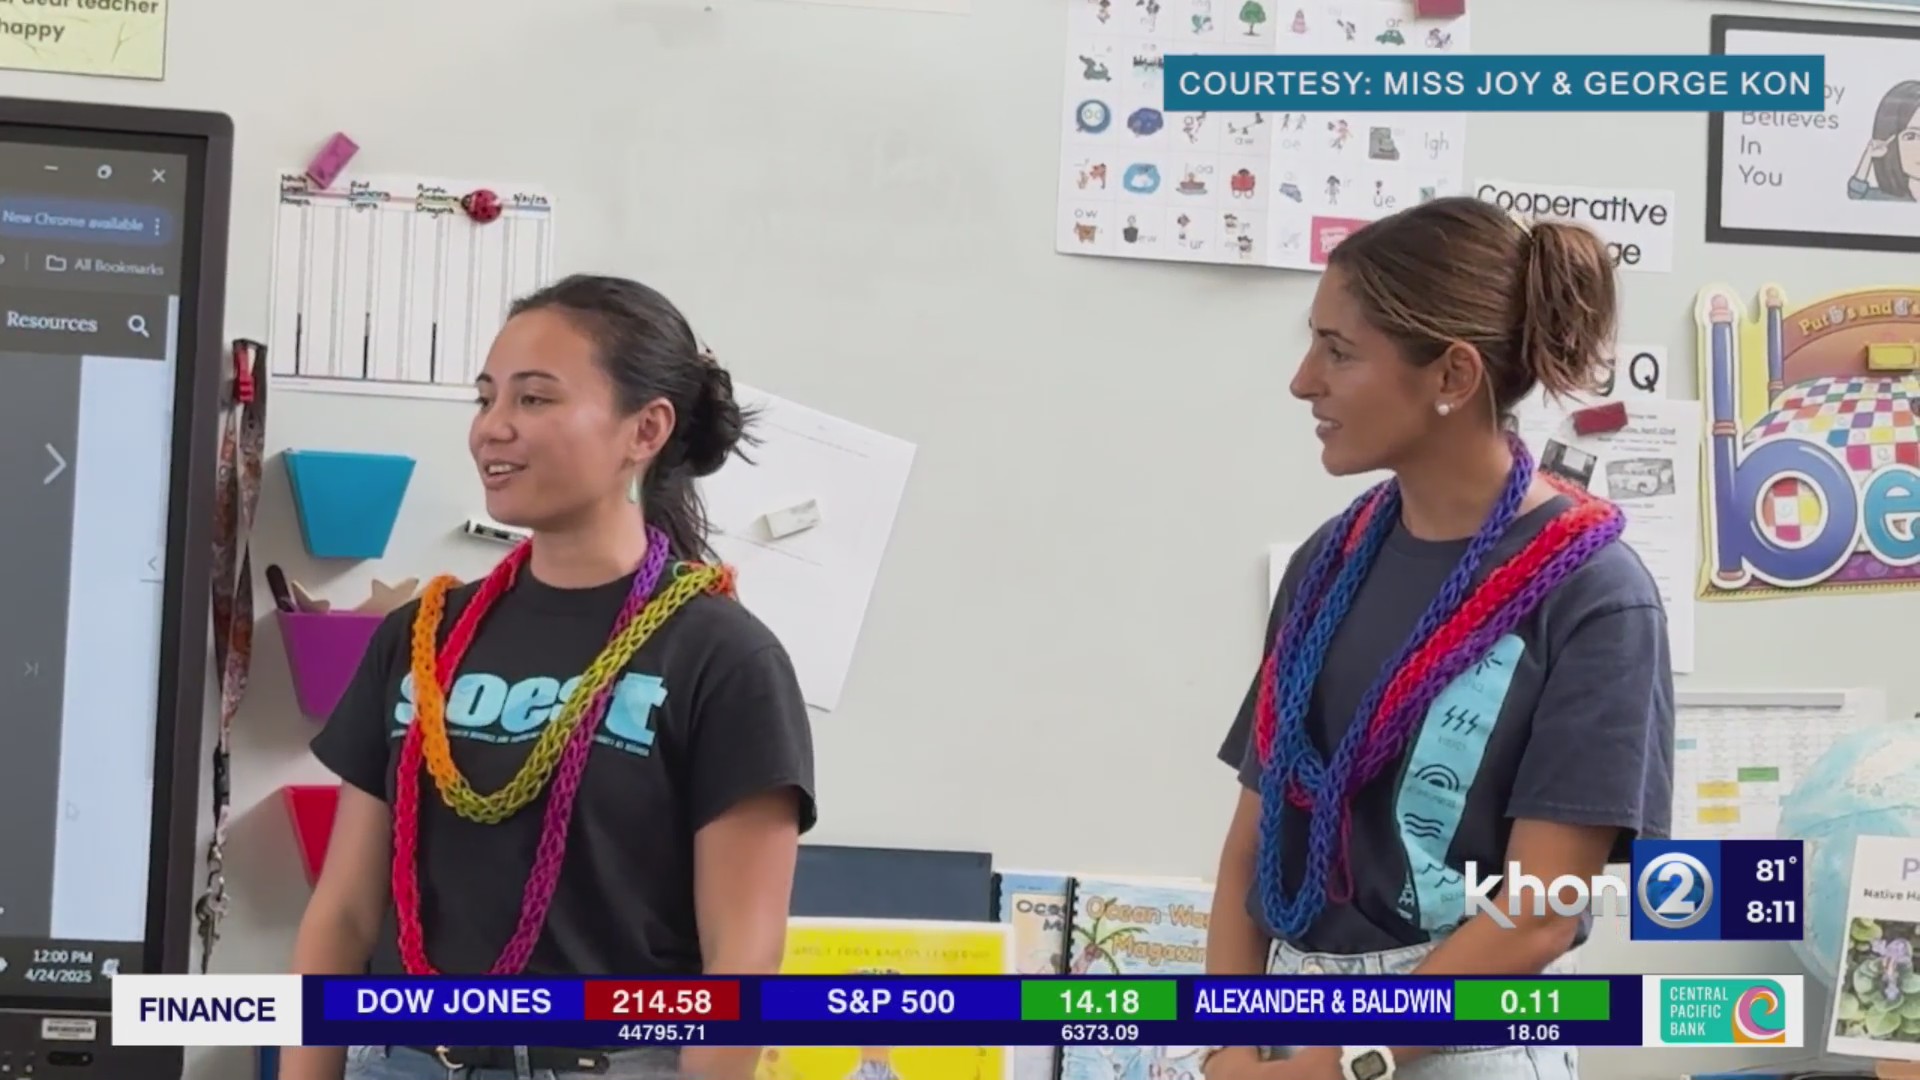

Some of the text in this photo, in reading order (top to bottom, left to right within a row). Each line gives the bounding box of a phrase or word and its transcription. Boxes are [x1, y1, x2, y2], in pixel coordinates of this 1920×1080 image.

[77, 0, 159, 14] teacher
[0, 18, 66, 43] happy
[1741, 112, 1840, 130] Believes
[1740, 135, 1762, 156] In
[1738, 164, 1783, 187] You
[1477, 183, 1668, 226] Cooperative
[3, 210, 144, 232] New Chrome available
[74, 258, 164, 277] All Bookmarks
[7, 310, 98, 333] Resources
[1629, 352, 1659, 393] Q
[1087, 896, 1162, 925] Ocean
[33, 949, 94, 963] 12:00 PM
[24, 967, 93, 983] 4/24/2025
